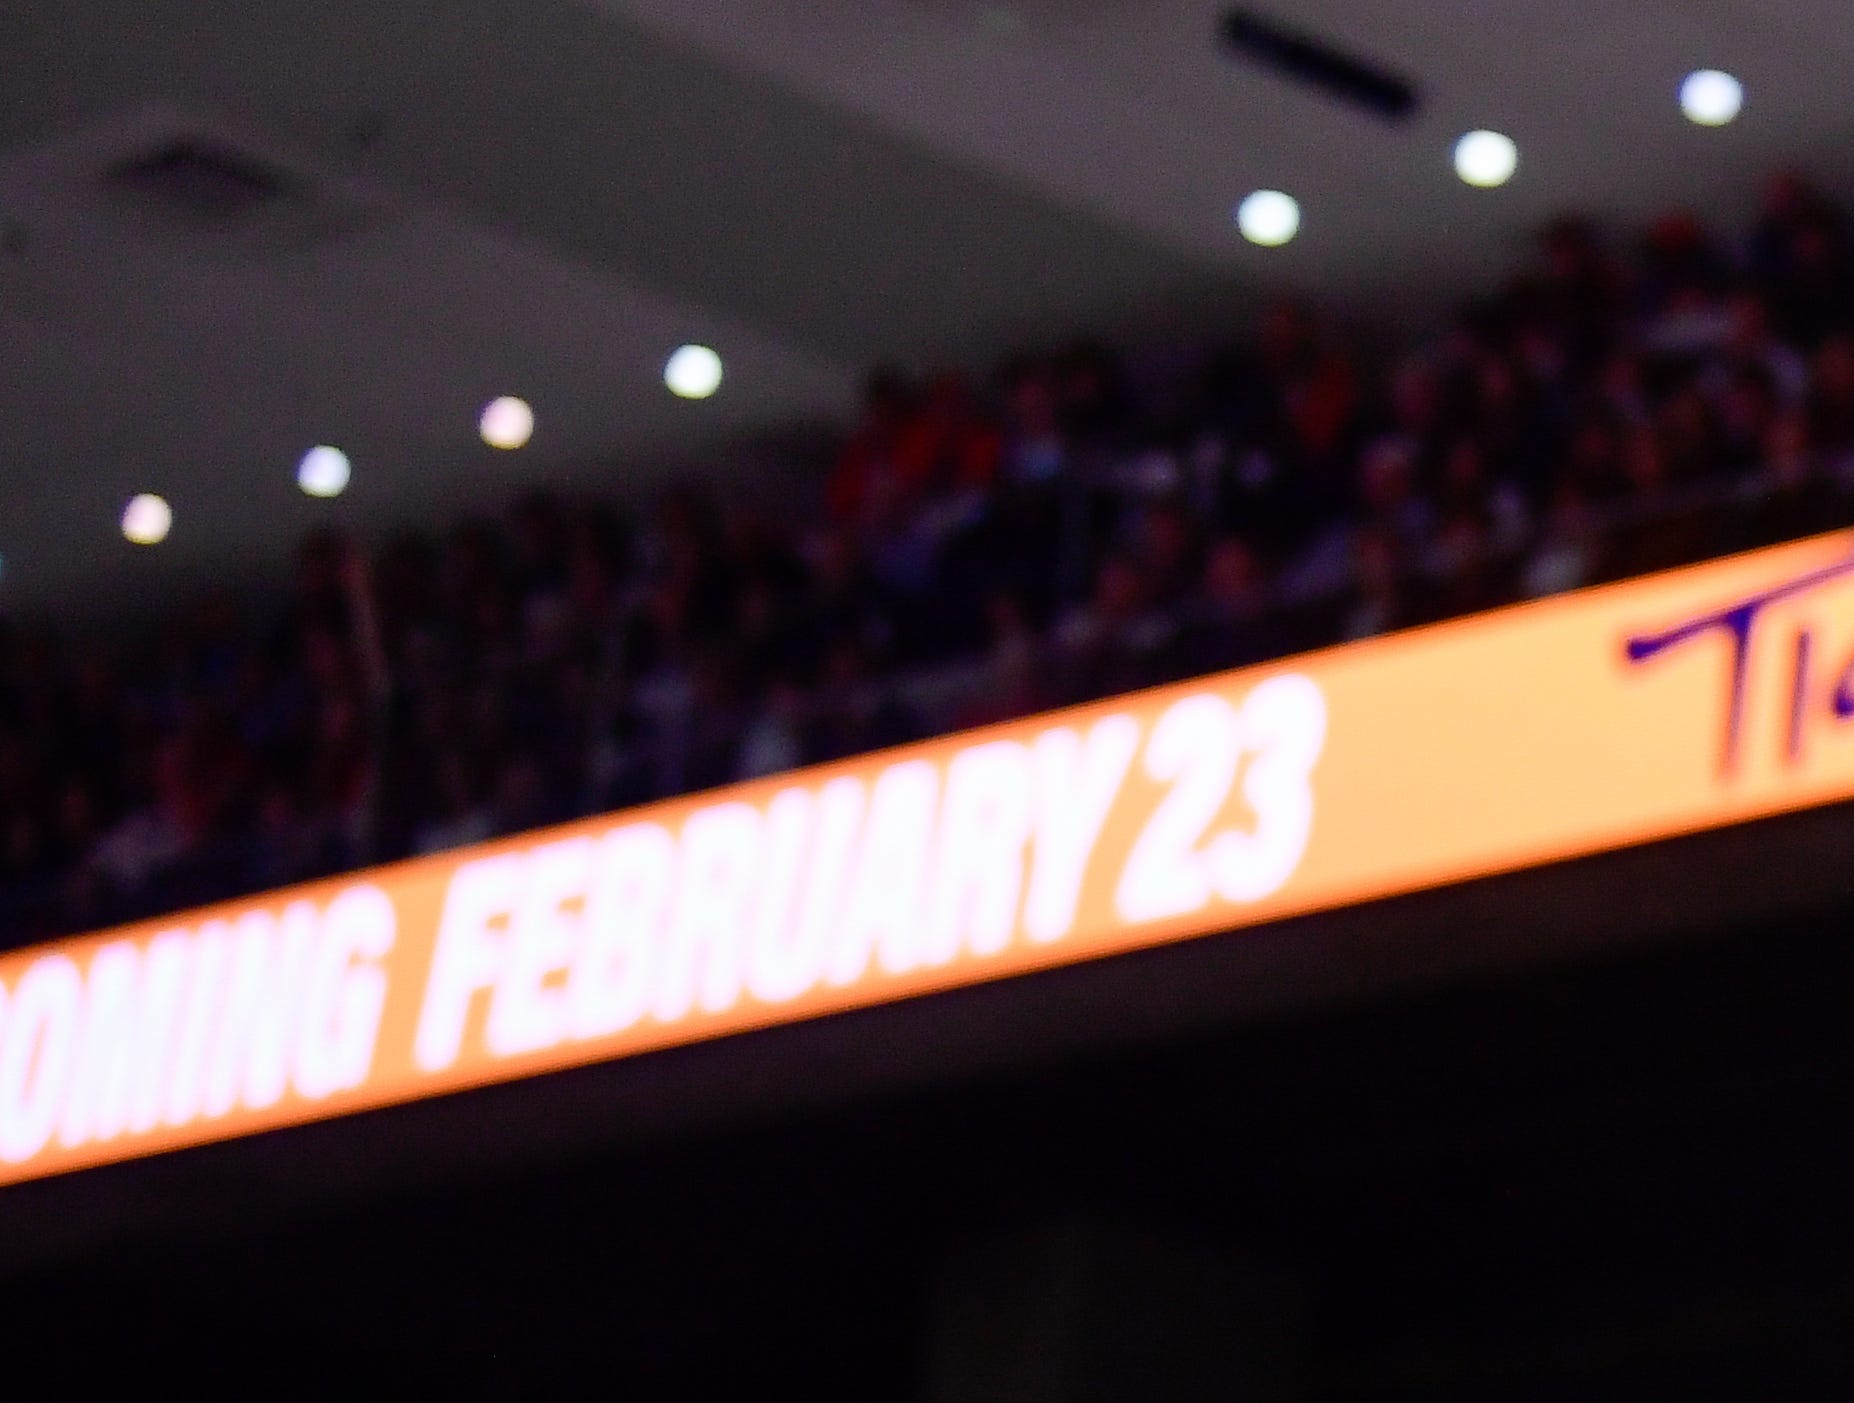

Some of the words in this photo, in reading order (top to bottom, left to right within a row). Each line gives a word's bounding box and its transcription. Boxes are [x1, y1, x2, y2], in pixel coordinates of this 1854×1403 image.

[0, 883, 397, 1162] OMING
[413, 714, 1140, 1072] FEBRUARY
[1115, 673, 1328, 924] 23
